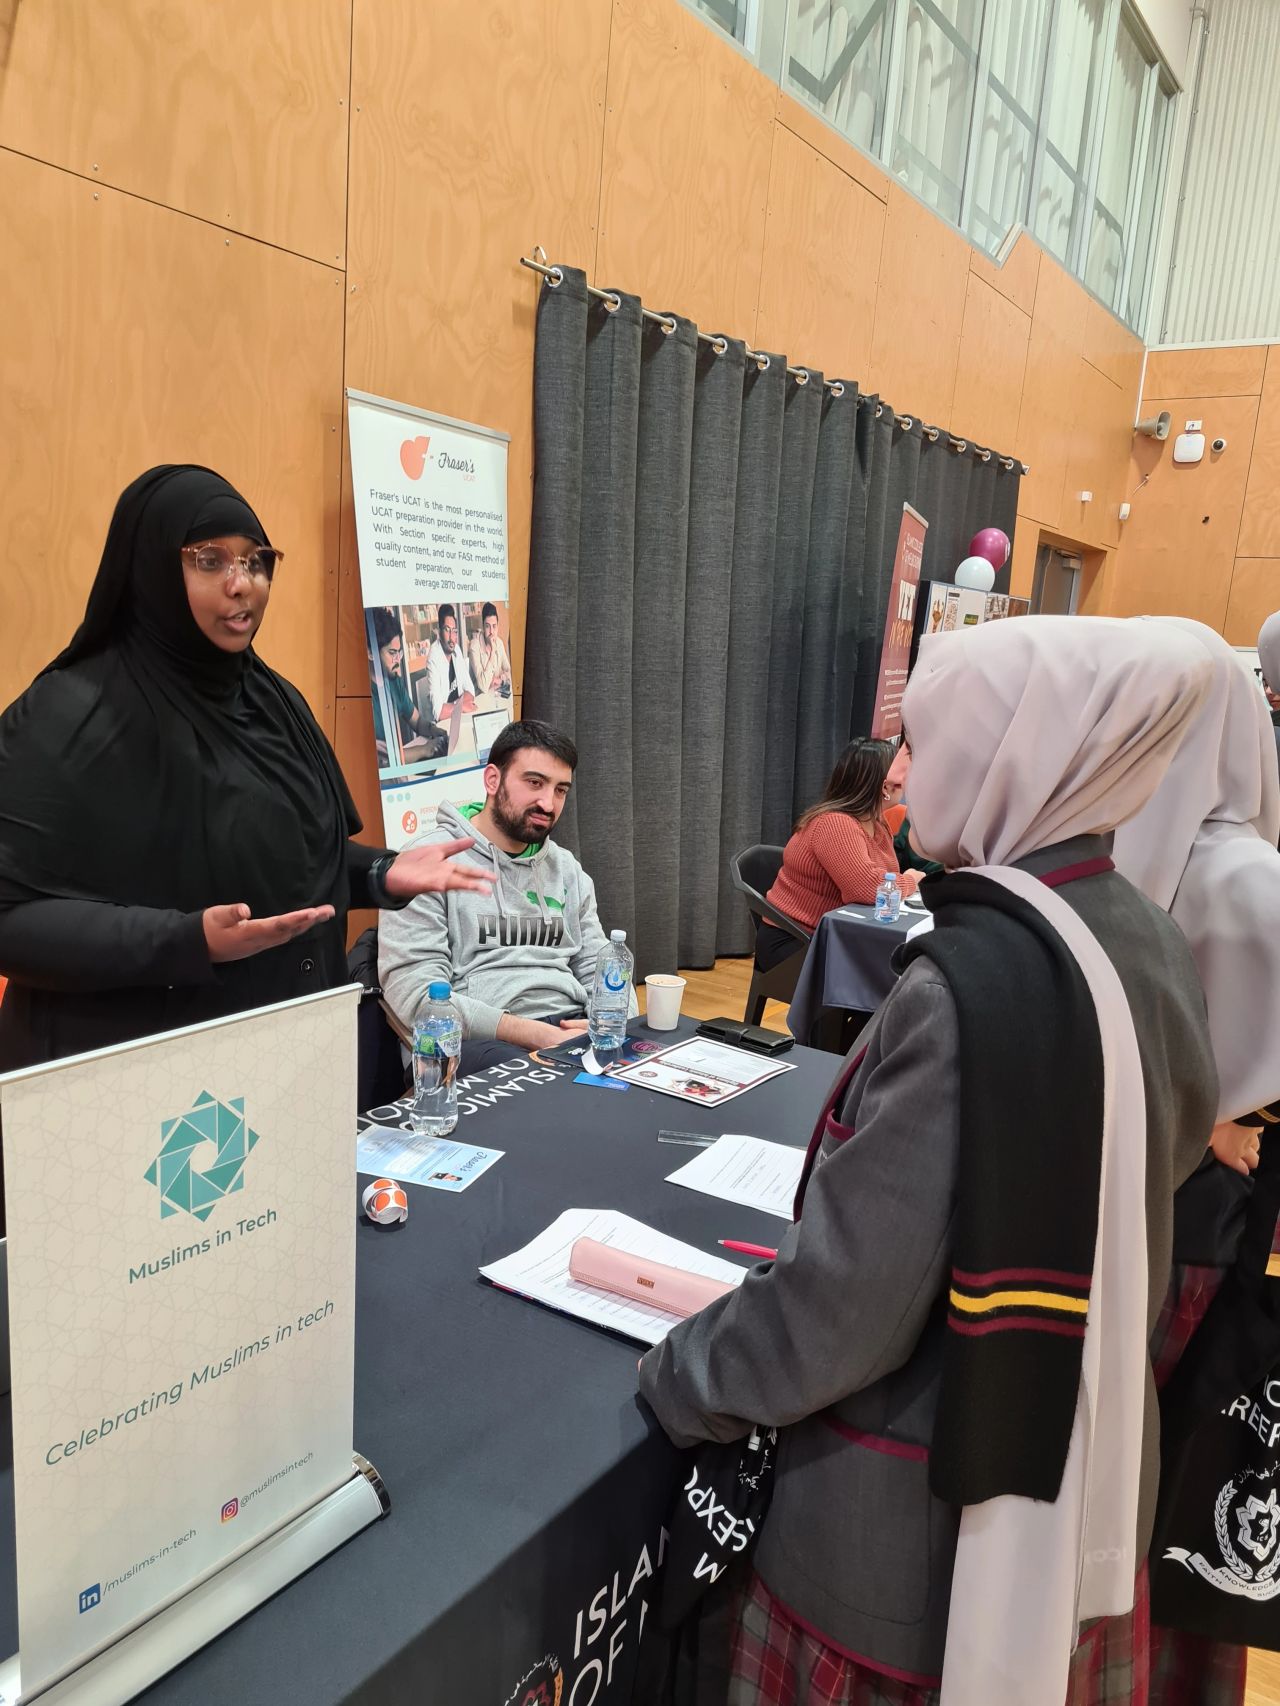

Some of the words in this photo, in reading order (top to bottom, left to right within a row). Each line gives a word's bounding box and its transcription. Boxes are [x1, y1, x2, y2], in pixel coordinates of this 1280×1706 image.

[438, 452, 475, 474] Fraser's
[370, 488, 400, 502] Fraser's
[402, 495, 421, 506] UCAT
[424, 498, 430, 508] is
[432, 501, 443, 512] the
[446, 505, 462, 515] most
[465, 508, 502, 522] personalised
[372, 506, 393, 518] UCAT
[396, 511, 434, 526] preparation
[437, 518, 463, 530] provider
[465, 522, 472, 531] in
[474, 524, 484, 534] the
[373, 522, 392, 534] With
[400, 526, 425, 540] Section
[431, 532, 456, 544] specific
[493, 541, 504, 552] high
[374, 541, 402, 554] quality
[432, 549, 444, 558] and
[446, 550, 456, 559] our
[475, 554, 500, 564] method
[376, 557, 406, 568] student
[414, 578, 440, 590] average
[441, 580, 456, 590] 2870
[478, 914, 564, 947] PUMA
[458, 1067, 566, 1115] ISLAMIC
[129, 1238, 210, 1284] Muslims
[216, 1230, 232, 1246] in
[236, 1208, 277, 1236] Tech
[46, 1382, 183, 1466] Celebrating
[190, 1334, 270, 1390] Muslims
[276, 1325, 292, 1344] in
[298, 1300, 334, 1331] tech
[240, 1451, 314, 1508] @muslimsintech
[104, 1528, 196, 1596] /muslims-in-tech
[1198, 1562, 1222, 1584] FAITH
[1219, 1570, 1274, 1591] KNOWLEDGE
